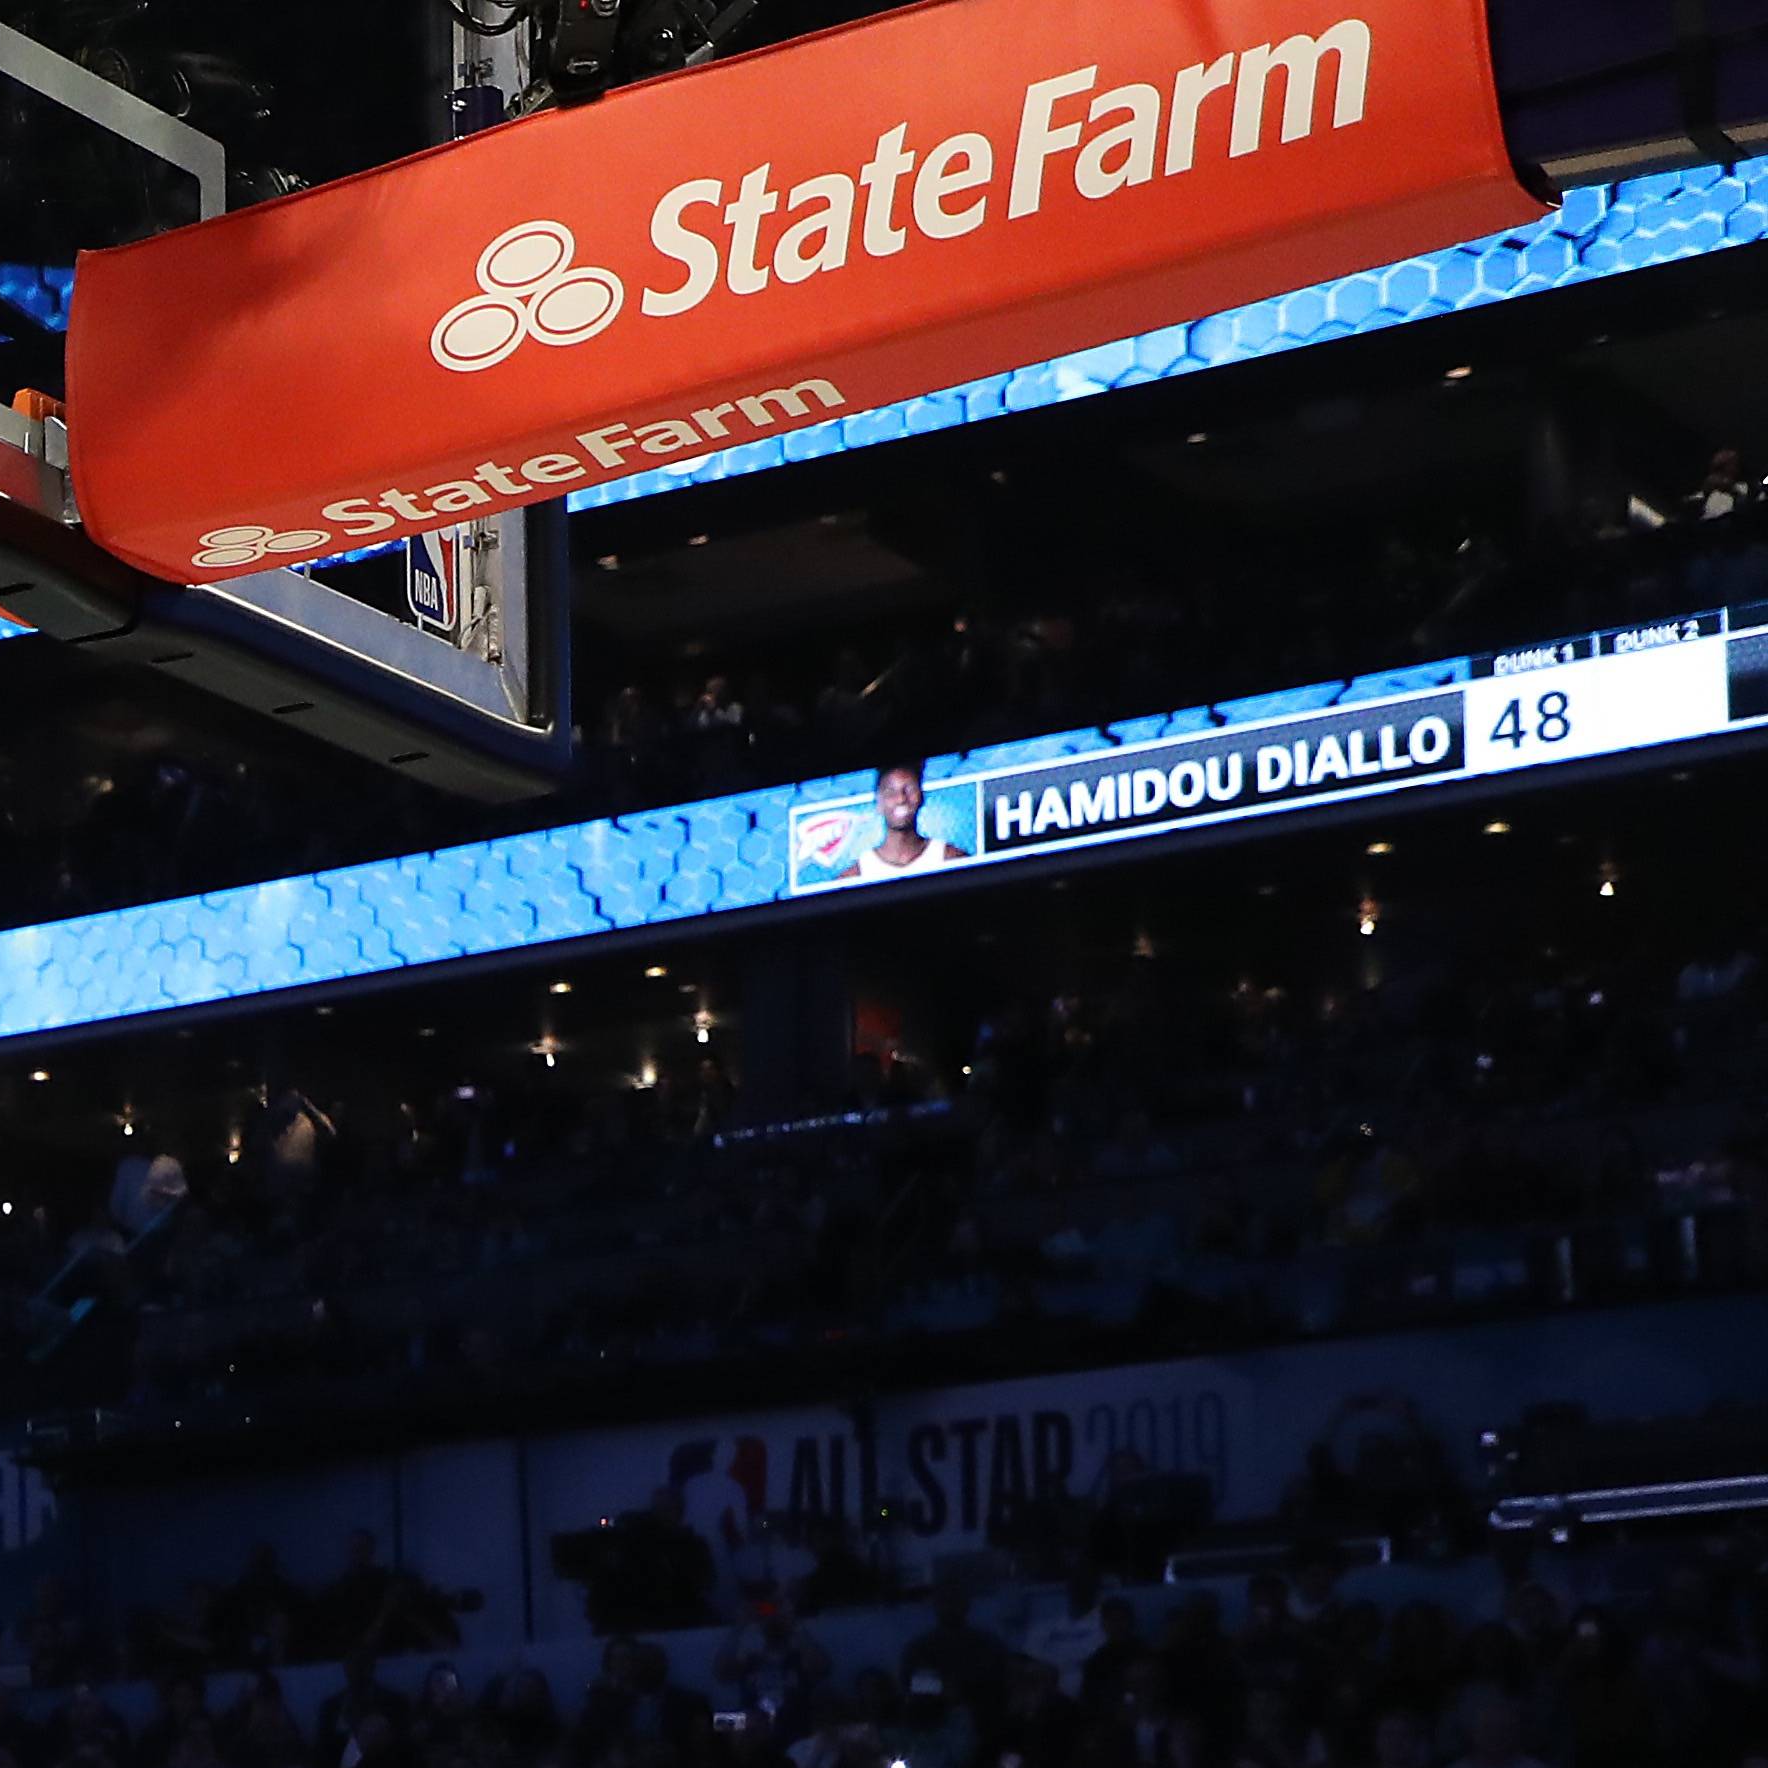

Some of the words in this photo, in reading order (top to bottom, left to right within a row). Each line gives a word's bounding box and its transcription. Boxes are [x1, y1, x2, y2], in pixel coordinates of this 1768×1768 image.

[415, 569, 439, 611] NBA
[1490, 691, 1571, 749] 48
[995, 752, 1243, 841] HAMIDOU
[1257, 716, 1450, 793] DIALLO
